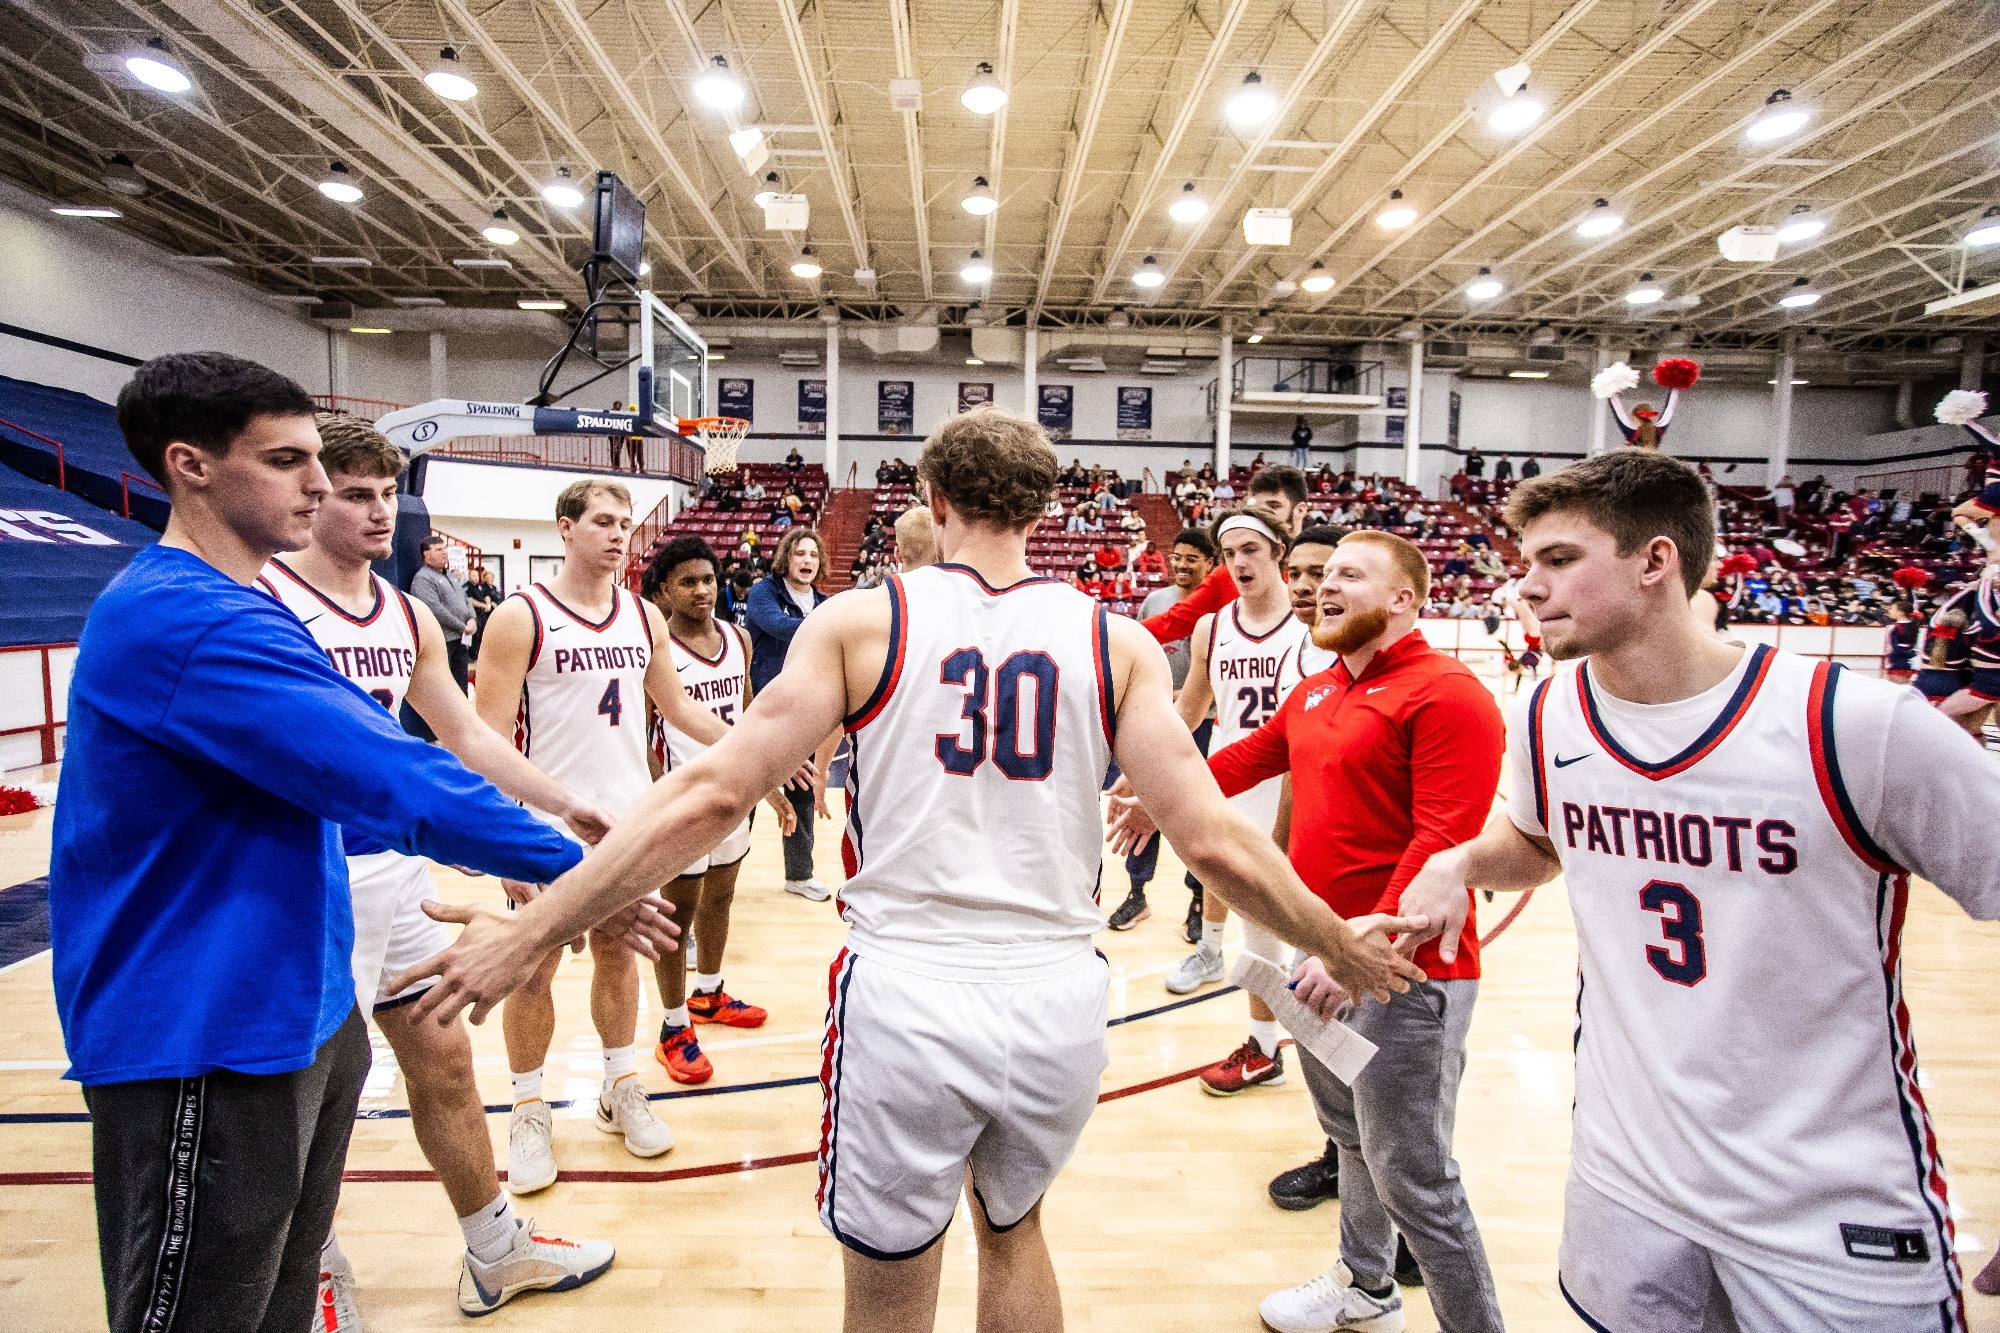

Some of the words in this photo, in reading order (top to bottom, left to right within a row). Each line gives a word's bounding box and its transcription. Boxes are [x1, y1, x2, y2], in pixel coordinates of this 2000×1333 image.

[466, 402, 520, 418] SPALDING
[577, 415, 633, 432] SPALDING
[324, 646, 413, 678] TRIOTS
[555, 646, 646, 674] PATRIOTS
[1220, 656, 1277, 681] PATRIO
[597, 677, 623, 727] 4
[935, 646, 1060, 781] 30
[1237, 685, 1277, 729] 25
[1562, 801, 1798, 875] PATRIOTS
[1638, 878, 1708, 988] 3
[181, 1094, 197, 1139] STRIPES
[173, 1199, 186, 1232] BRAND
[167, 1234, 184, 1256] THE
[1906, 1239, 1919, 1254] L
